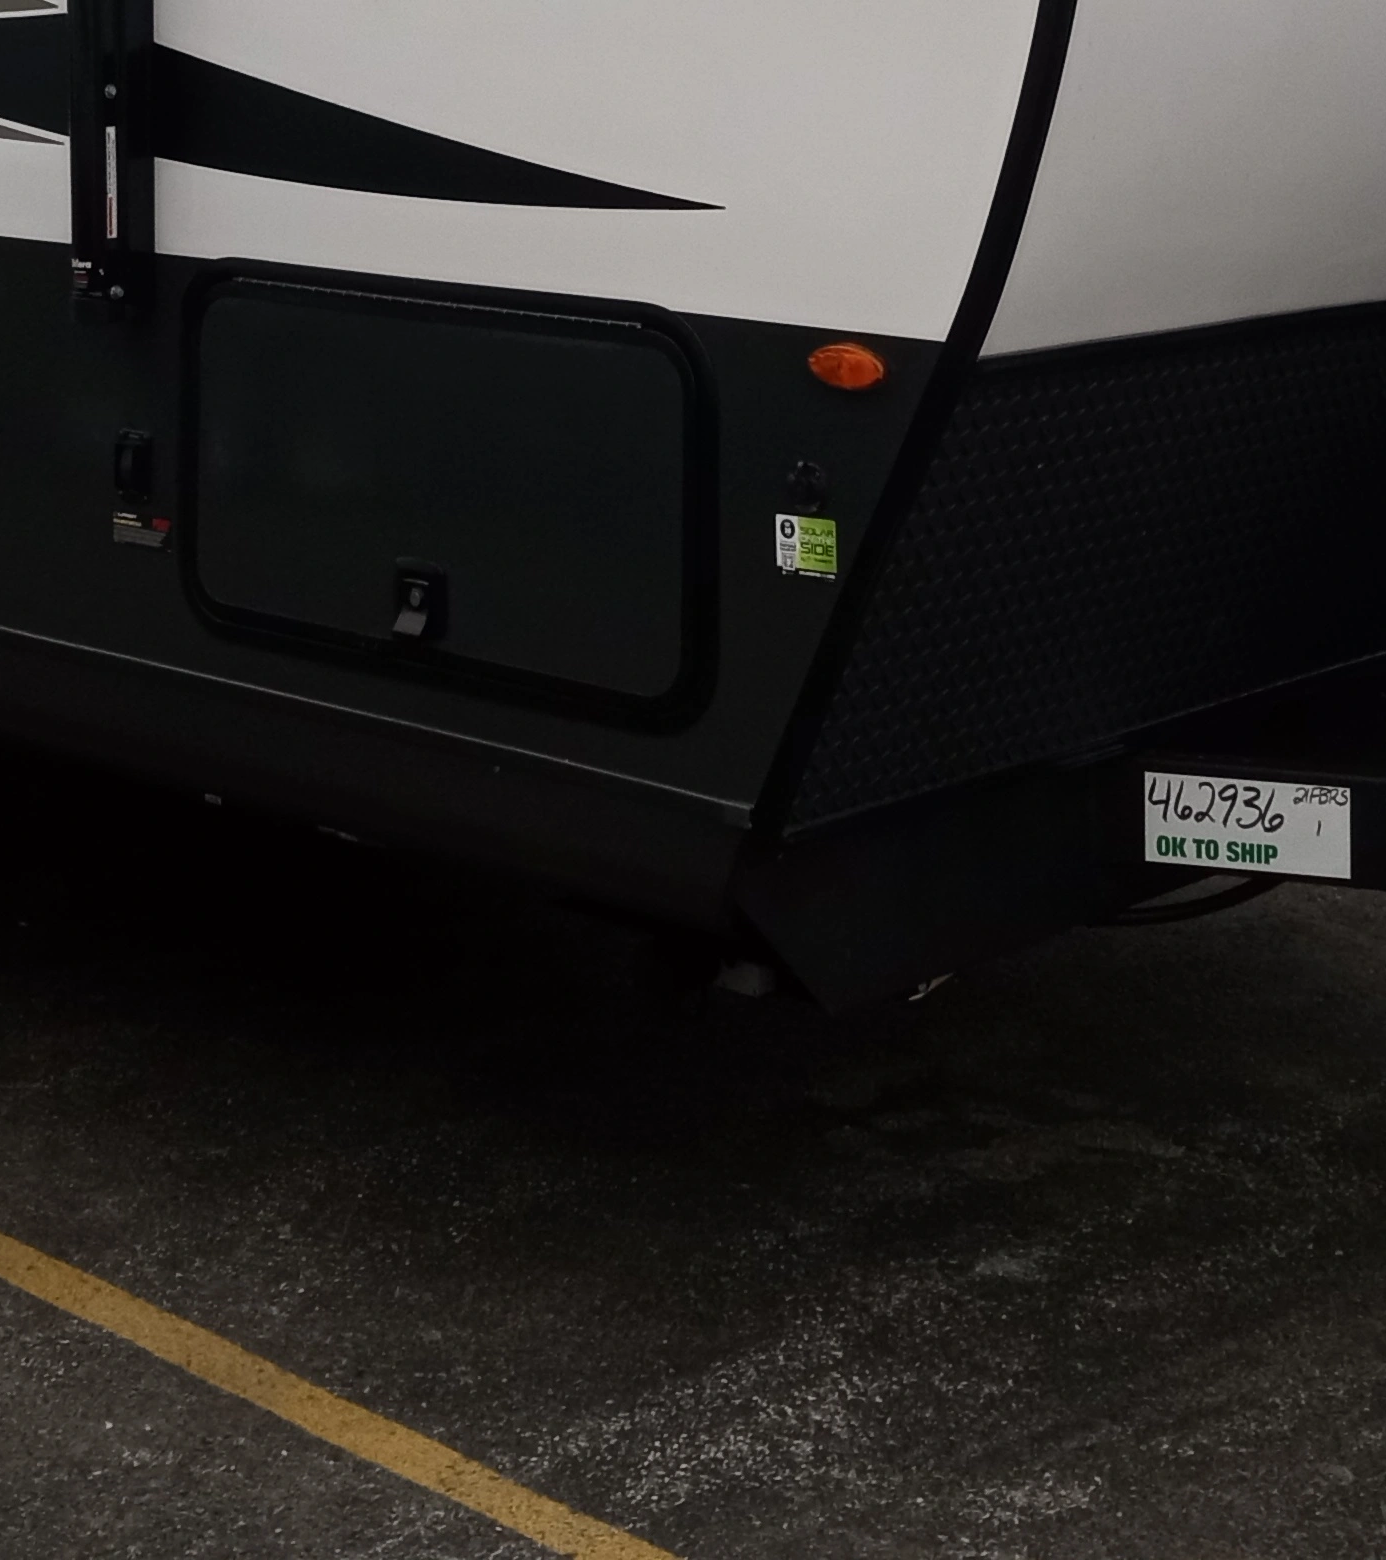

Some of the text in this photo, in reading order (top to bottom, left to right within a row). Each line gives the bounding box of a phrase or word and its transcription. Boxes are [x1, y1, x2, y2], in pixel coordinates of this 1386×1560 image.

[800, 542, 835, 558] SIDE
[1147, 776, 1285, 833] 462936
[1156, 835, 1279, 865] OK TO SHIP
